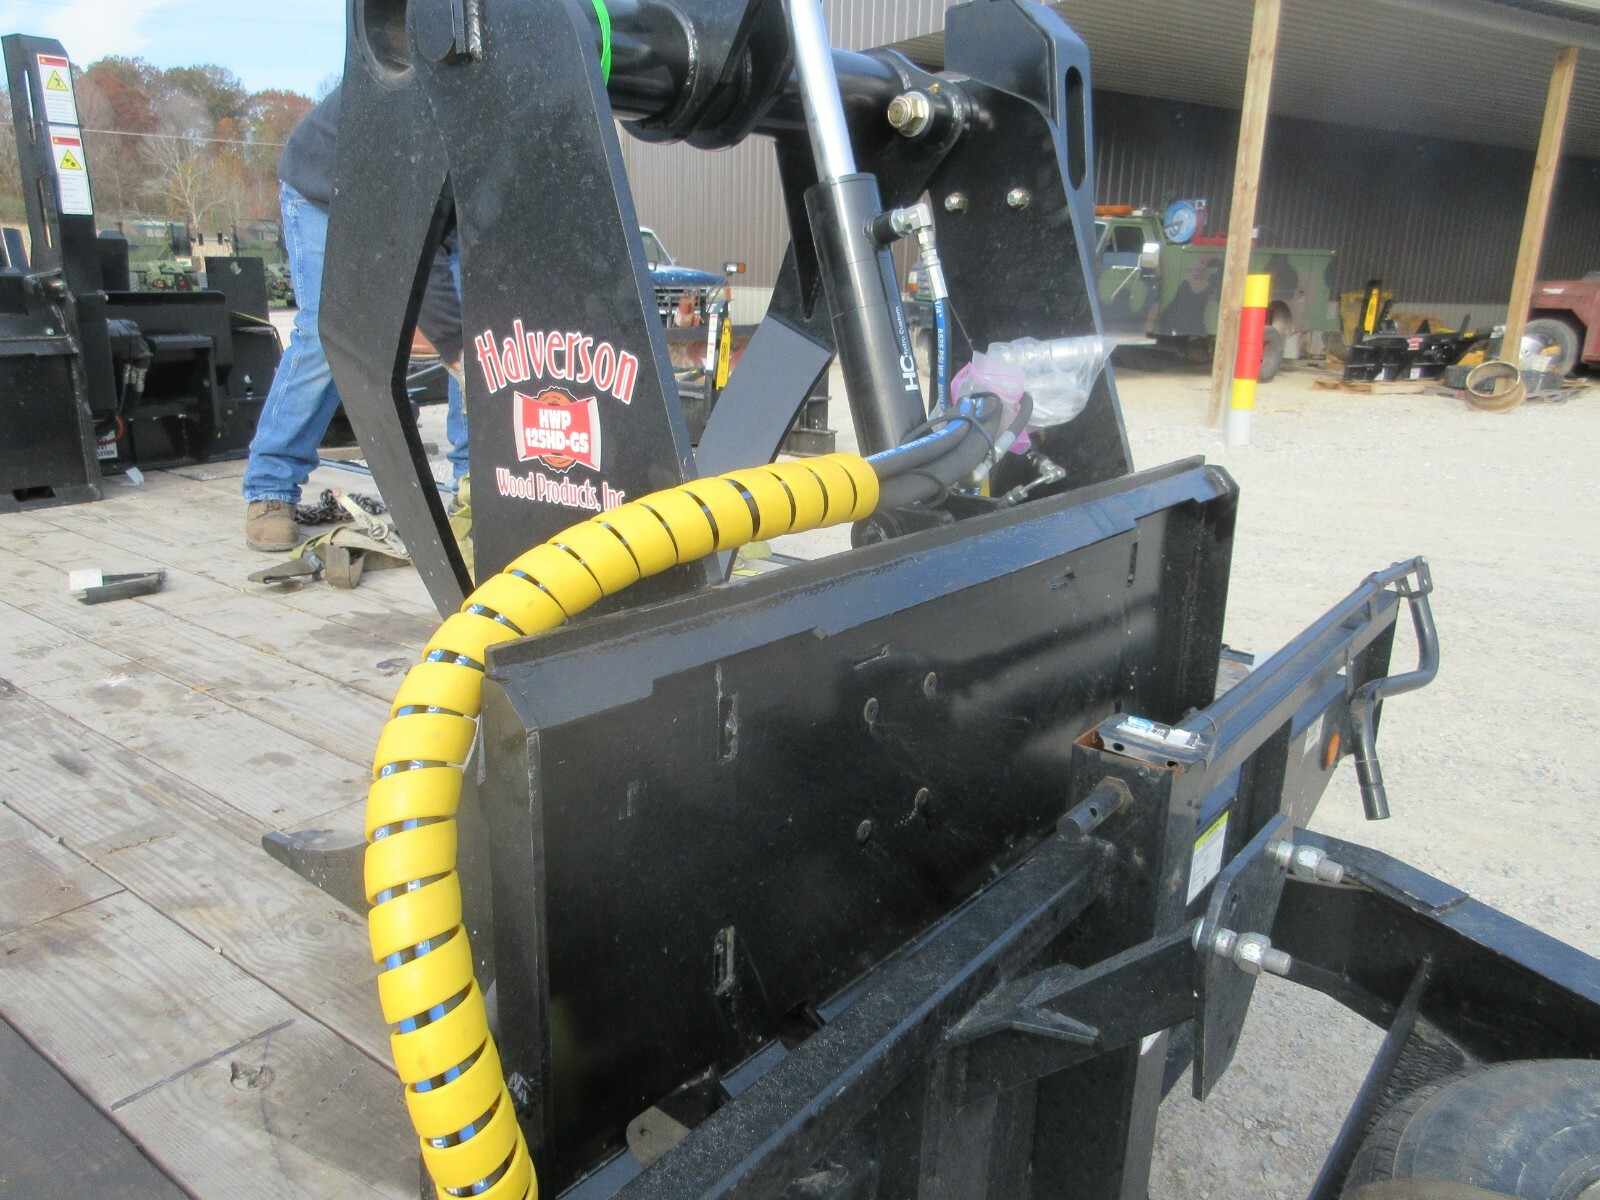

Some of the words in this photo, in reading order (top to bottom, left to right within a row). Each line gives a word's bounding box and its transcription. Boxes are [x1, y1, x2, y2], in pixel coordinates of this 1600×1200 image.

[895, 306, 904, 334] Custom
[901, 335, 909, 358] Hydro
[475, 319, 638, 405] Halverson
[900, 355, 918, 391] HC
[539, 409, 571, 430] HWP
[525, 427, 589, 453] 125HD-GS
[496, 468, 535, 499] Wood
[536, 472, 601, 512] Products,
